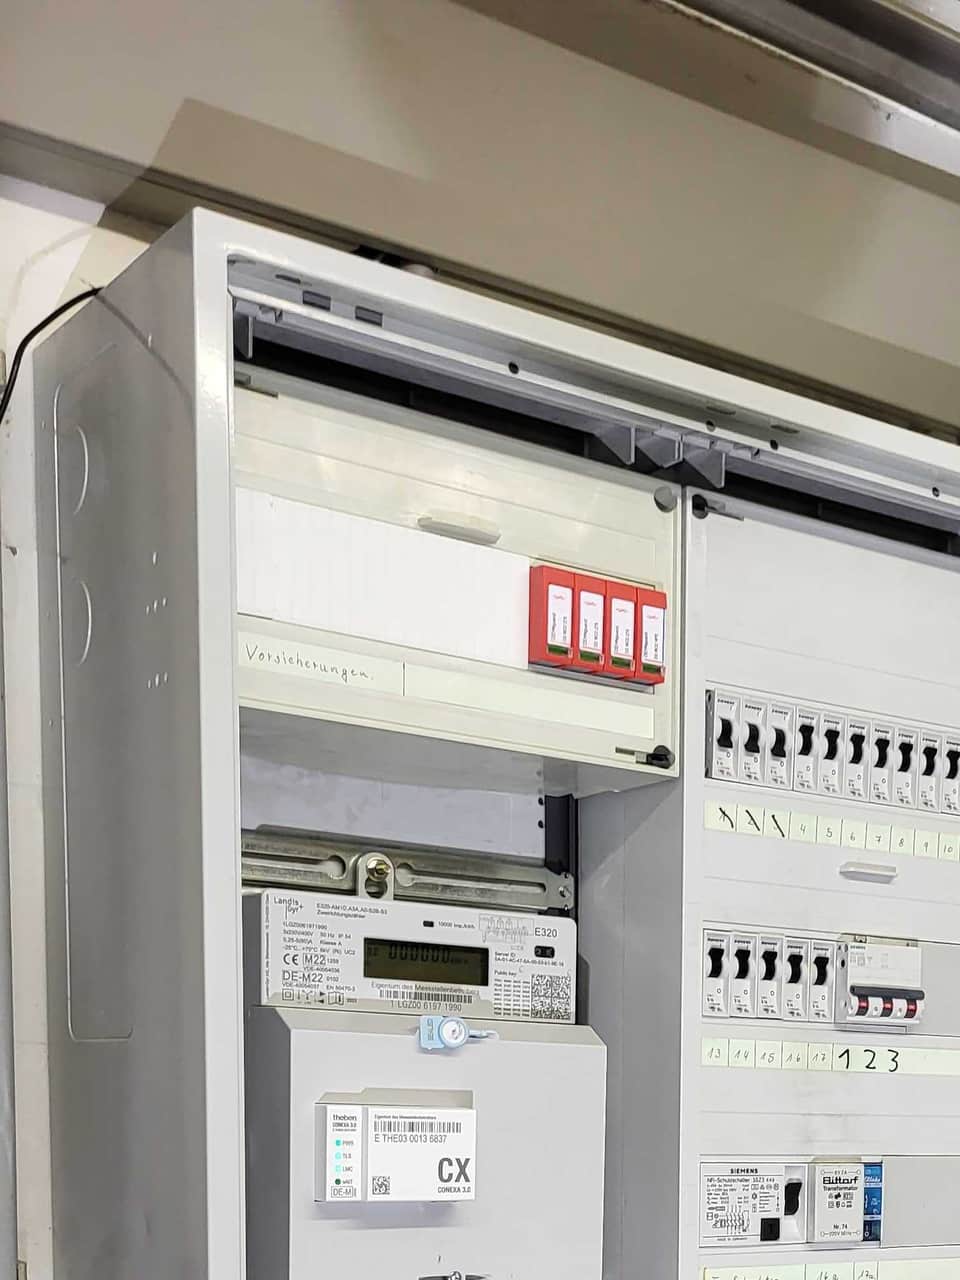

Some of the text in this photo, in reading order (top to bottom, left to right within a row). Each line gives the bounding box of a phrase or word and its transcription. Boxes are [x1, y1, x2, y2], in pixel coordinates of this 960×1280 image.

[799, 823, 807, 836] 4
[825, 827, 833, 838] 5
[849, 831, 856, 841] 6
[874, 834, 882, 843] 7
[898, 837, 905, 848] 8
[923, 841, 929, 853] 9
[943, 844, 953, 854] 10
[273, 897, 299, 906] Landis
[534, 926, 558, 938] E320
[304, 953, 326, 966] M22
[282, 969, 324, 983] DE-M22
[397, 1000, 421, 1009] LGZ00
[423, 1002, 442, 1010] 6197
[444, 1003, 463, 1012] 1990
[708, 1047, 721, 1059] 13
[734, 1049, 749, 1060] 14
[760, 1051, 776, 1064] 15
[786, 1052, 801, 1063] 16
[811, 1053, 826, 1062] 17
[837, 1048, 900, 1072] 1 2 3
[374, 1133, 448, 1144] E THE03 0013 6837
[437, 1157, 471, 1183] CX
[332, 1187, 352, 1197] DE-M
[437, 1186, 461, 1194] CONEXA
